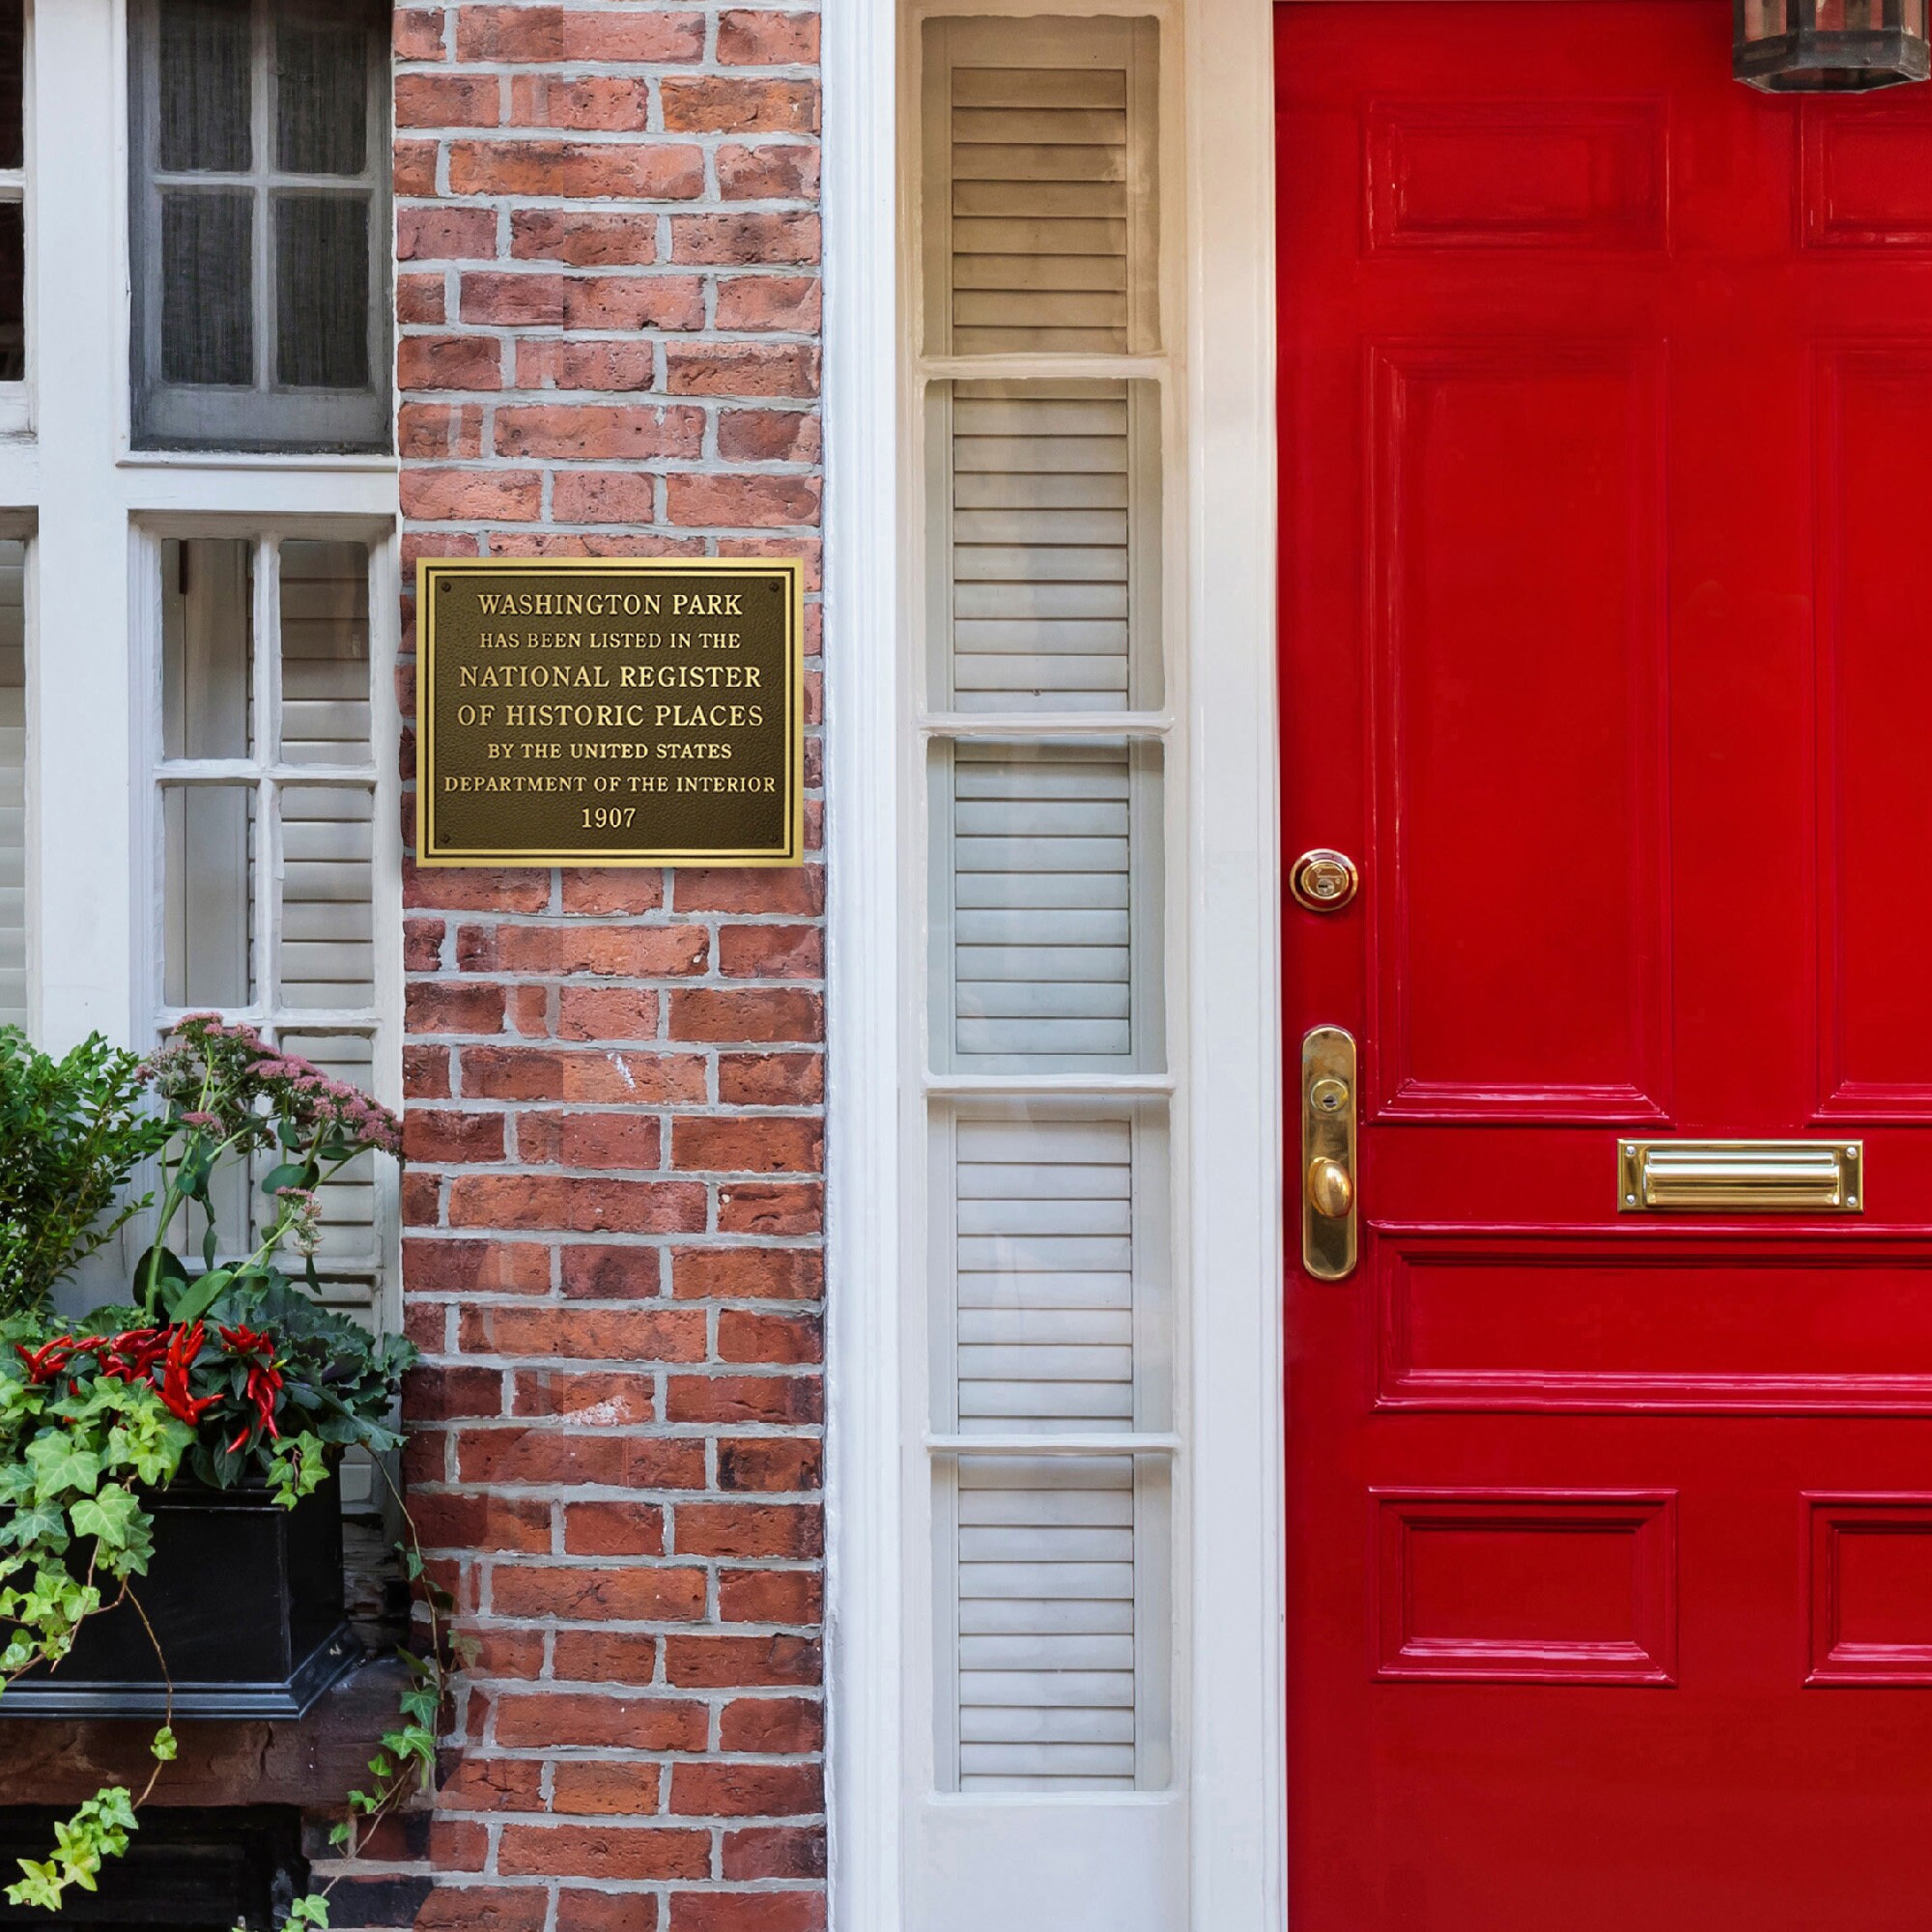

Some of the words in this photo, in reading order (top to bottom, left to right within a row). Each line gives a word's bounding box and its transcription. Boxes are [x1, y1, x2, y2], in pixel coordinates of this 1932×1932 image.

[476, 594, 662, 615] WASHINGTON
[672, 594, 743, 615] PARK
[479, 633, 520, 648] HAS
[527, 633, 582, 648] BEEN
[589, 633, 662, 648] LISTED
[669, 633, 691, 648] IN
[697, 633, 741, 649] THE
[459, 665, 611, 688] NATIONAL
[619, 666, 762, 688] REGISTER
[457, 704, 496, 726] OF
[505, 704, 644, 726] HISTORIC
[654, 704, 763, 726] PLACES
[488, 743, 515, 758] BY
[520, 743, 562, 758] THE
[569, 743, 649, 759] UNITED
[656, 743, 732, 759] STATES
[444, 776, 587, 792] DEPARTMENT
[593, 776, 622, 792] OF
[626, 776, 668, 792] THE
[676, 777, 776, 793] INTERIOR
[582, 808, 637, 829] 1907
